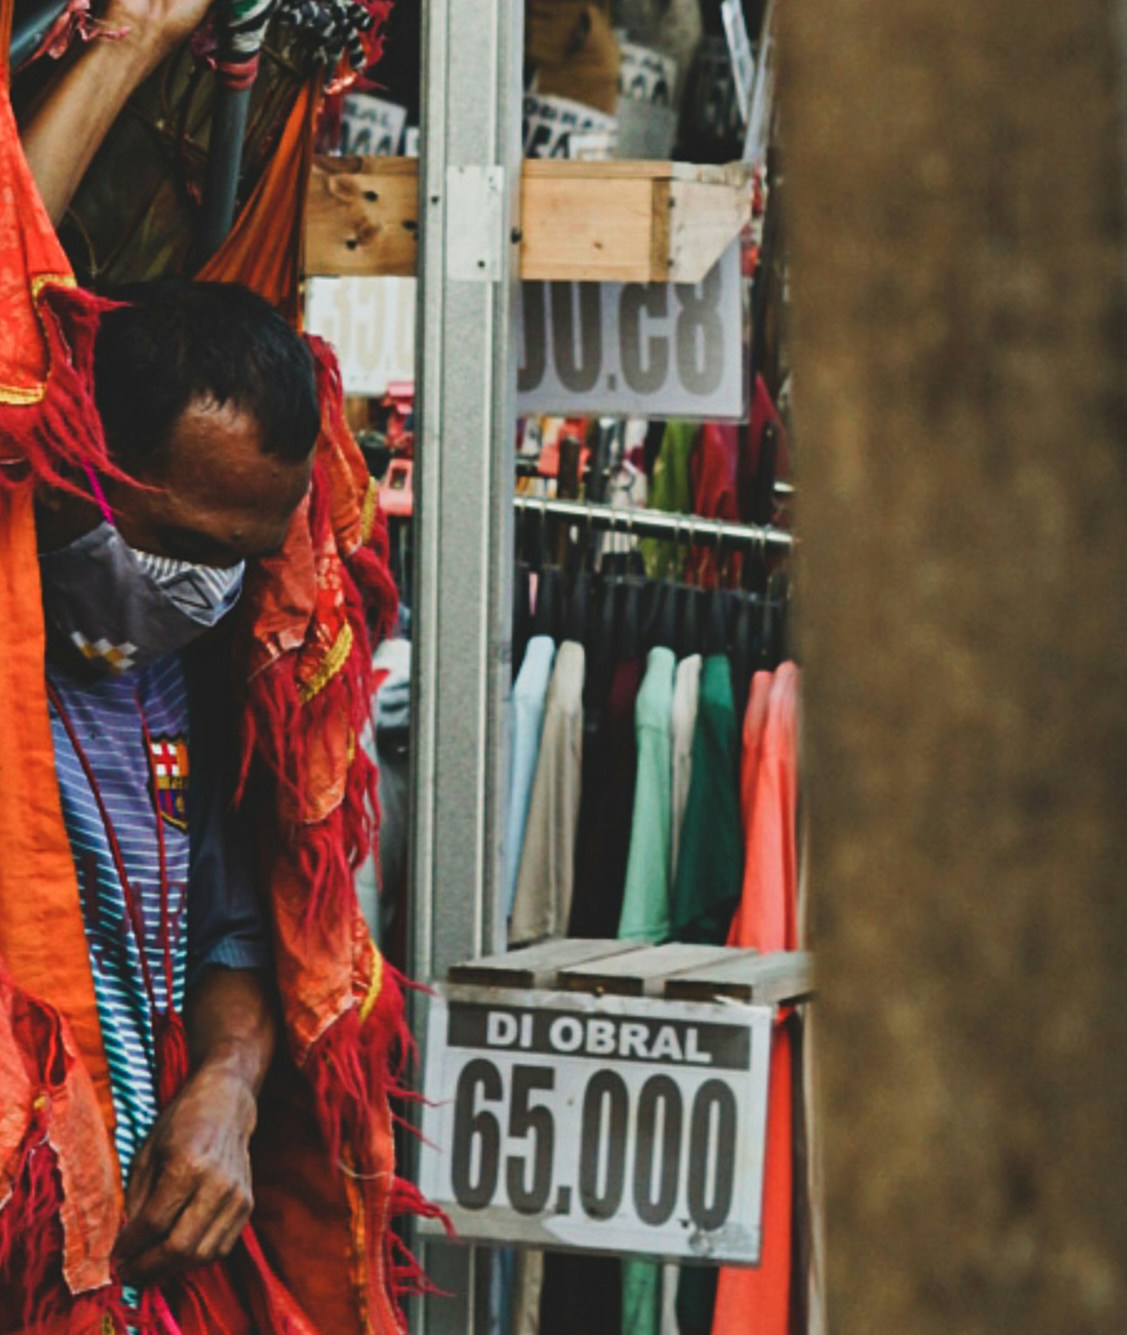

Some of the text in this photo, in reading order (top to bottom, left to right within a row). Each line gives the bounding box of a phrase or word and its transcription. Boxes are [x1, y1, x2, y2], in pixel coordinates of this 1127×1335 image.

[486, 1010, 712, 1063] DI OBRAL
[451, 1057, 738, 1232] 65.000
